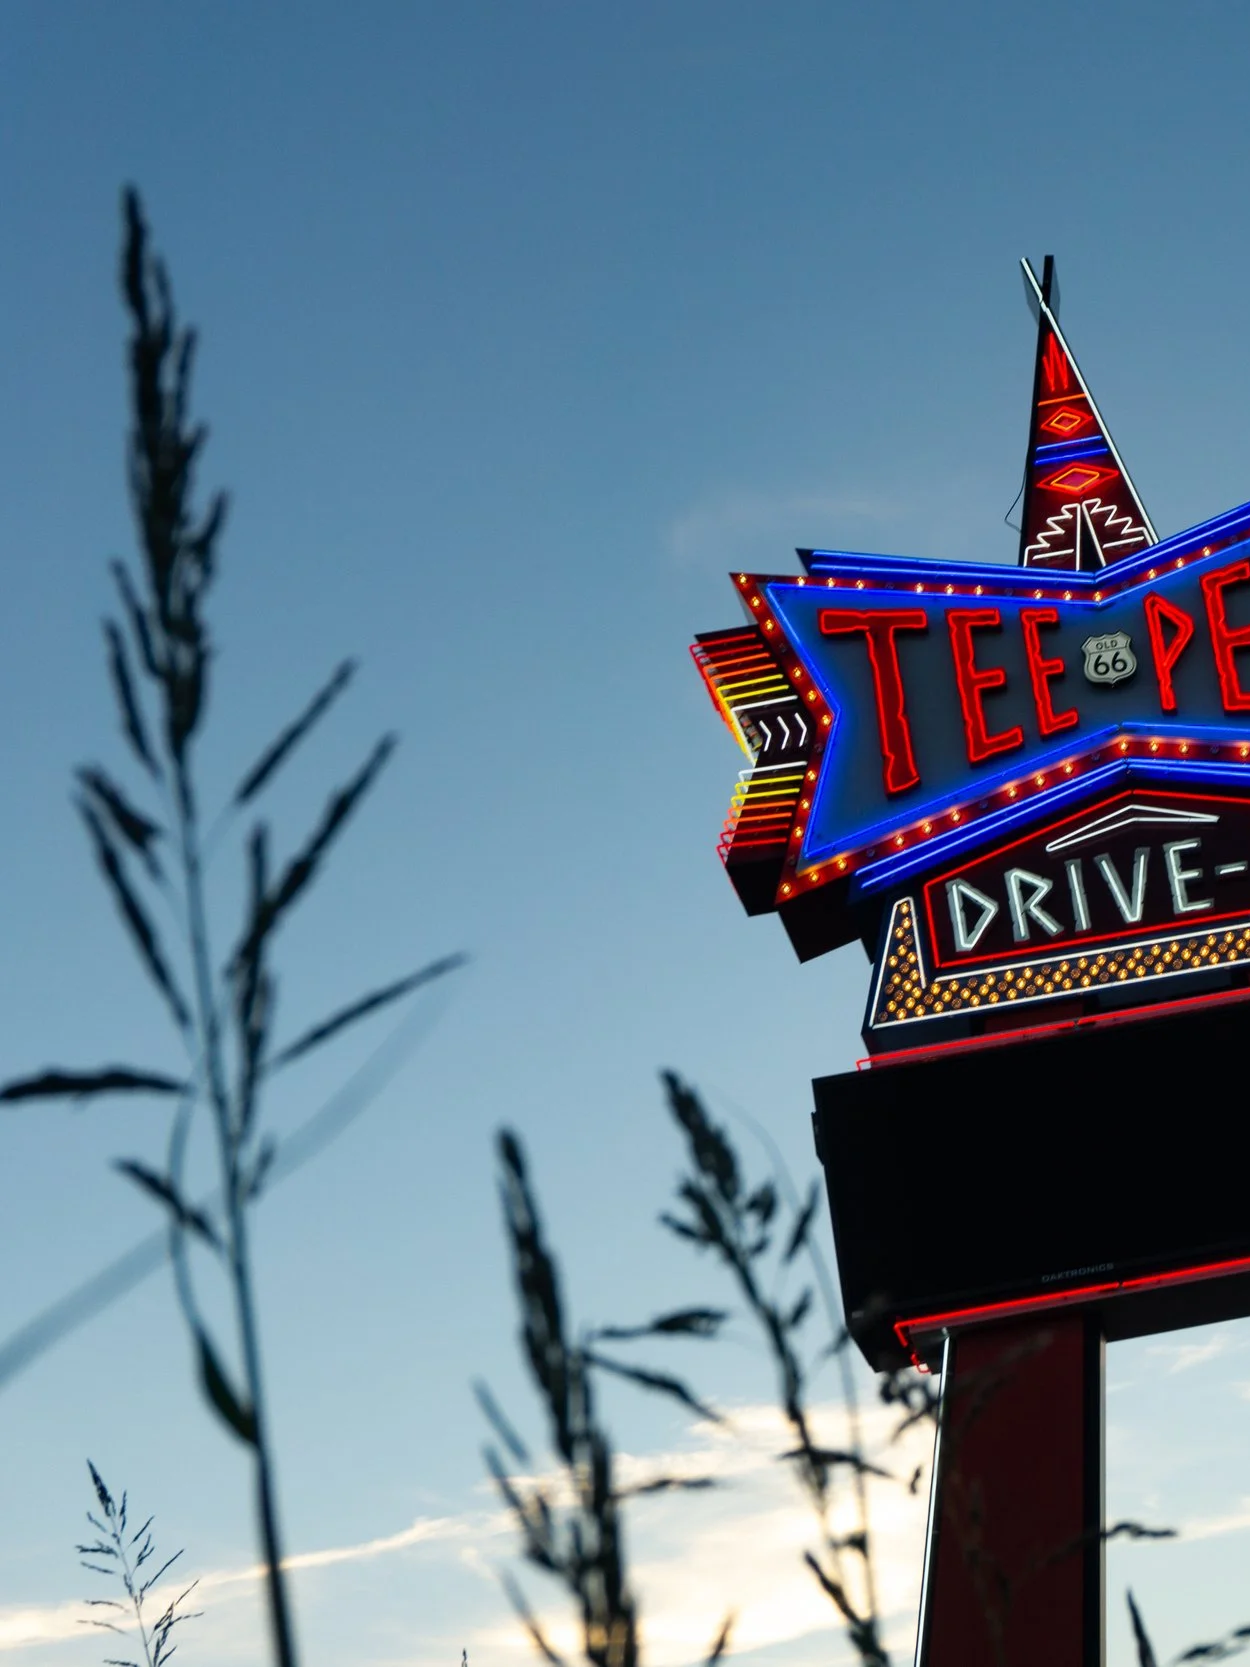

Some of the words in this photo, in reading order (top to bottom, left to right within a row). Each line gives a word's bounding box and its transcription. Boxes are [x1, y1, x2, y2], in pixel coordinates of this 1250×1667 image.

[1095, 639, 1118, 650] OLD
[1094, 651, 1127, 675] 66
[820, 609, 1079, 793] TEE
